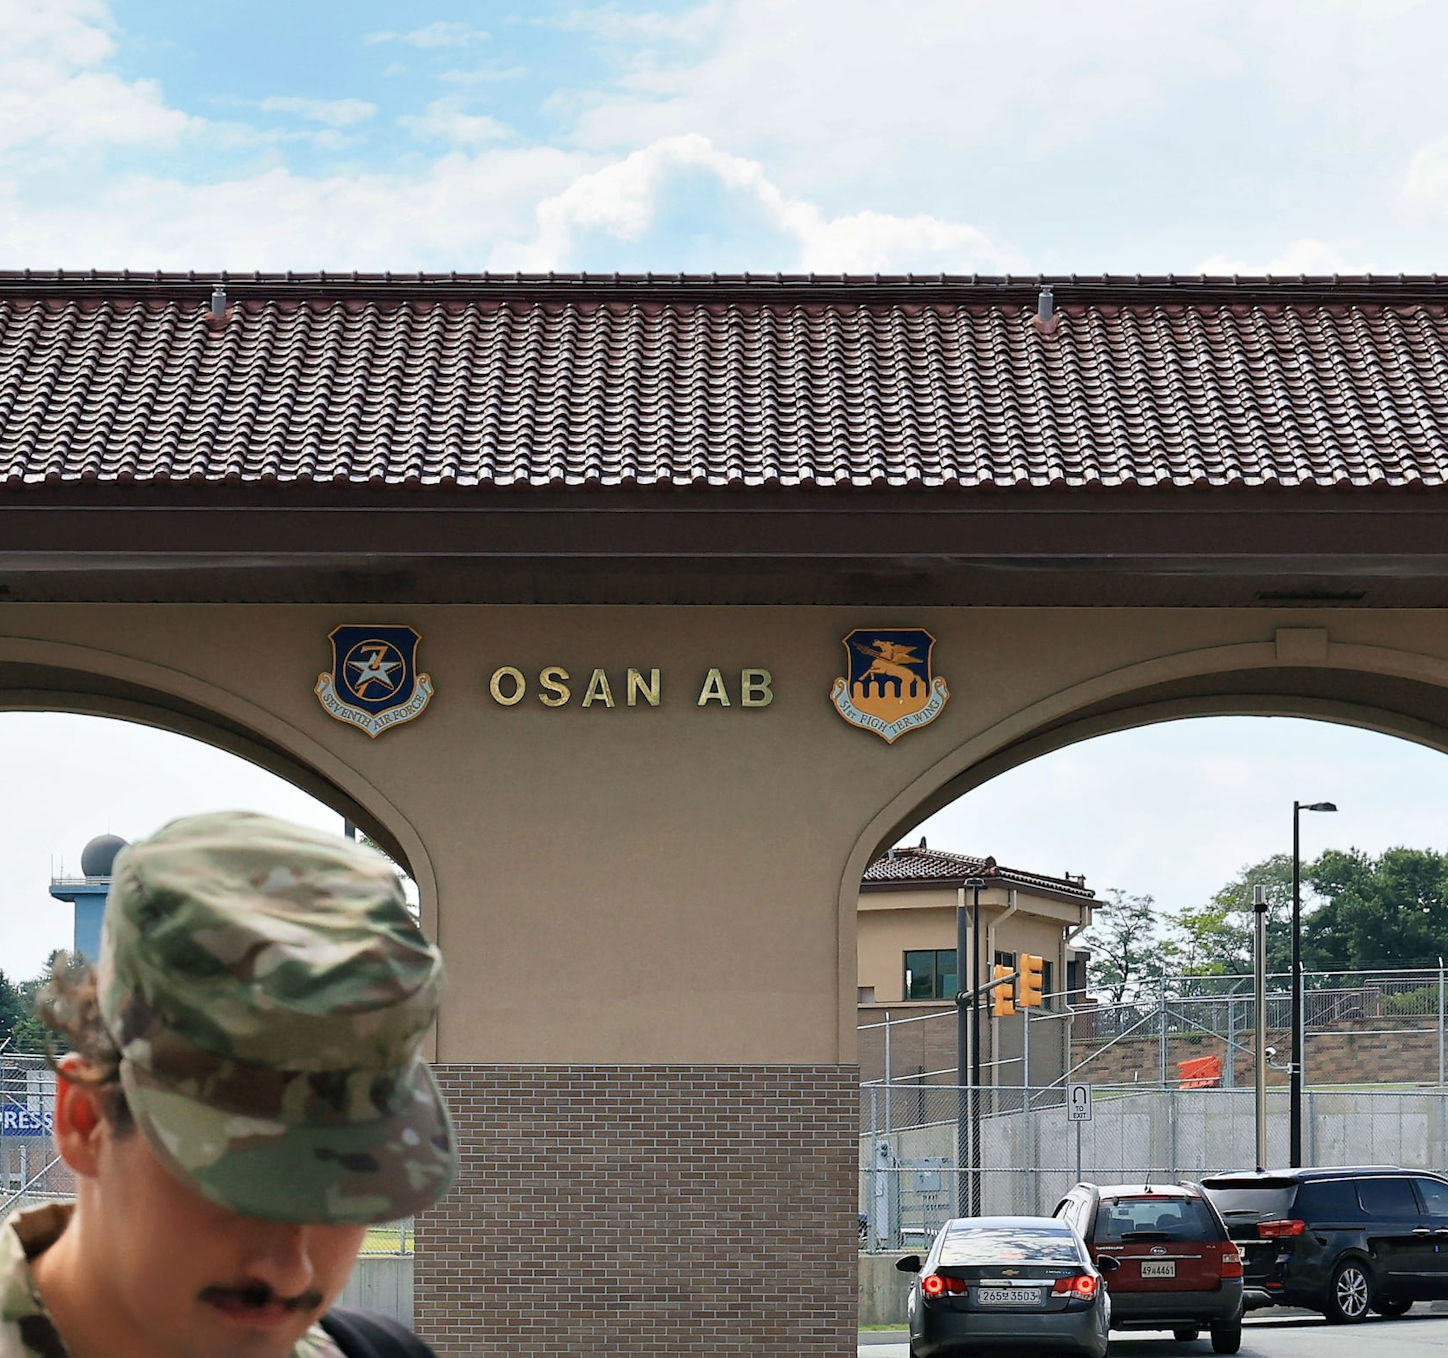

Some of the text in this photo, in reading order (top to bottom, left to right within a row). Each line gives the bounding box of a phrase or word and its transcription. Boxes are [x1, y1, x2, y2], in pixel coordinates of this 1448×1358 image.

[489, 666, 774, 708] OSAN AB
[323, 694, 425, 730] SEVENTH AIR FORCE
[913, 699, 941, 722] WING
